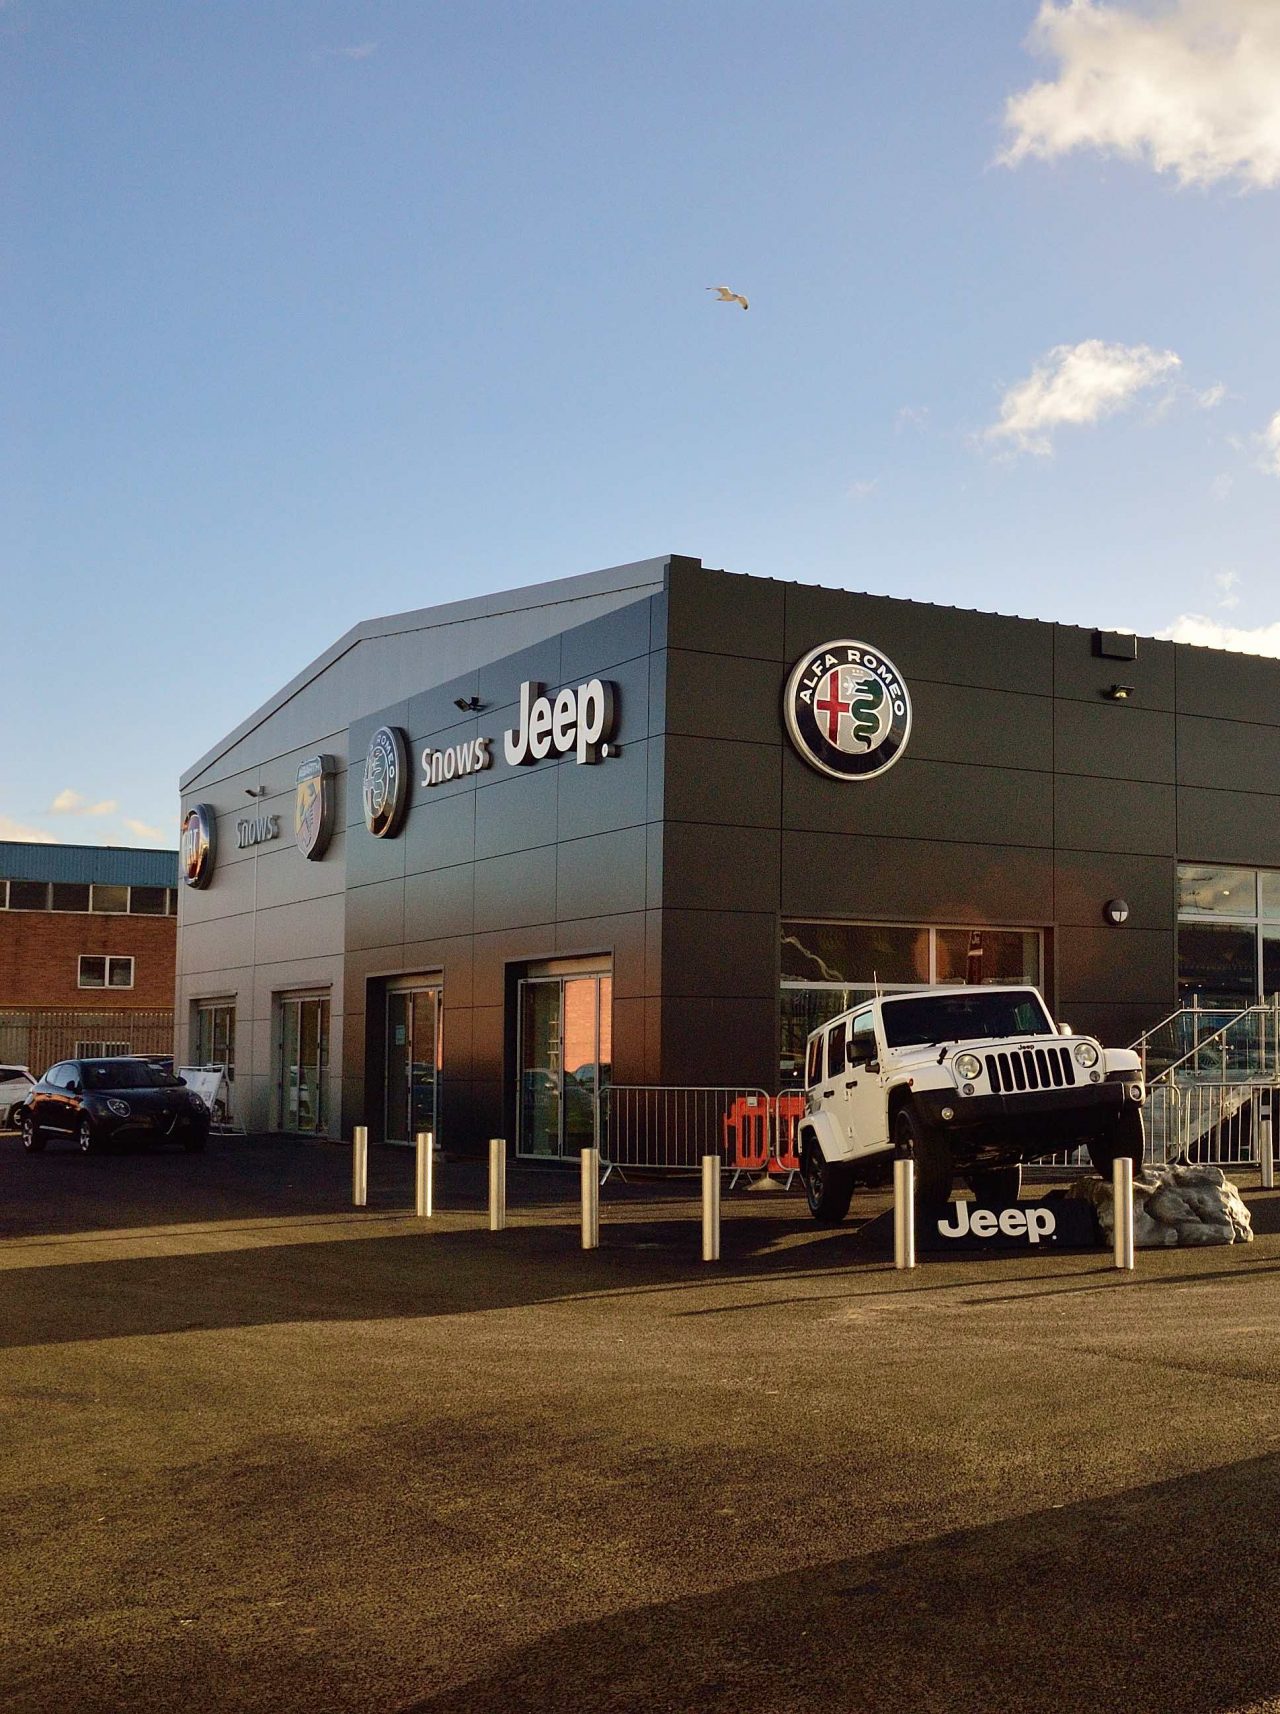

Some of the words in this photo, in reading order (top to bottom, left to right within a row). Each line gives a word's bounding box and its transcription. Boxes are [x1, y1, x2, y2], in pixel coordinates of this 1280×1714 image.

[799, 653, 839, 705] ALFA
[847, 649, 906, 717] ROMEO
[421, 736, 489, 788] Snows
[236, 815, 277, 849] Snows
